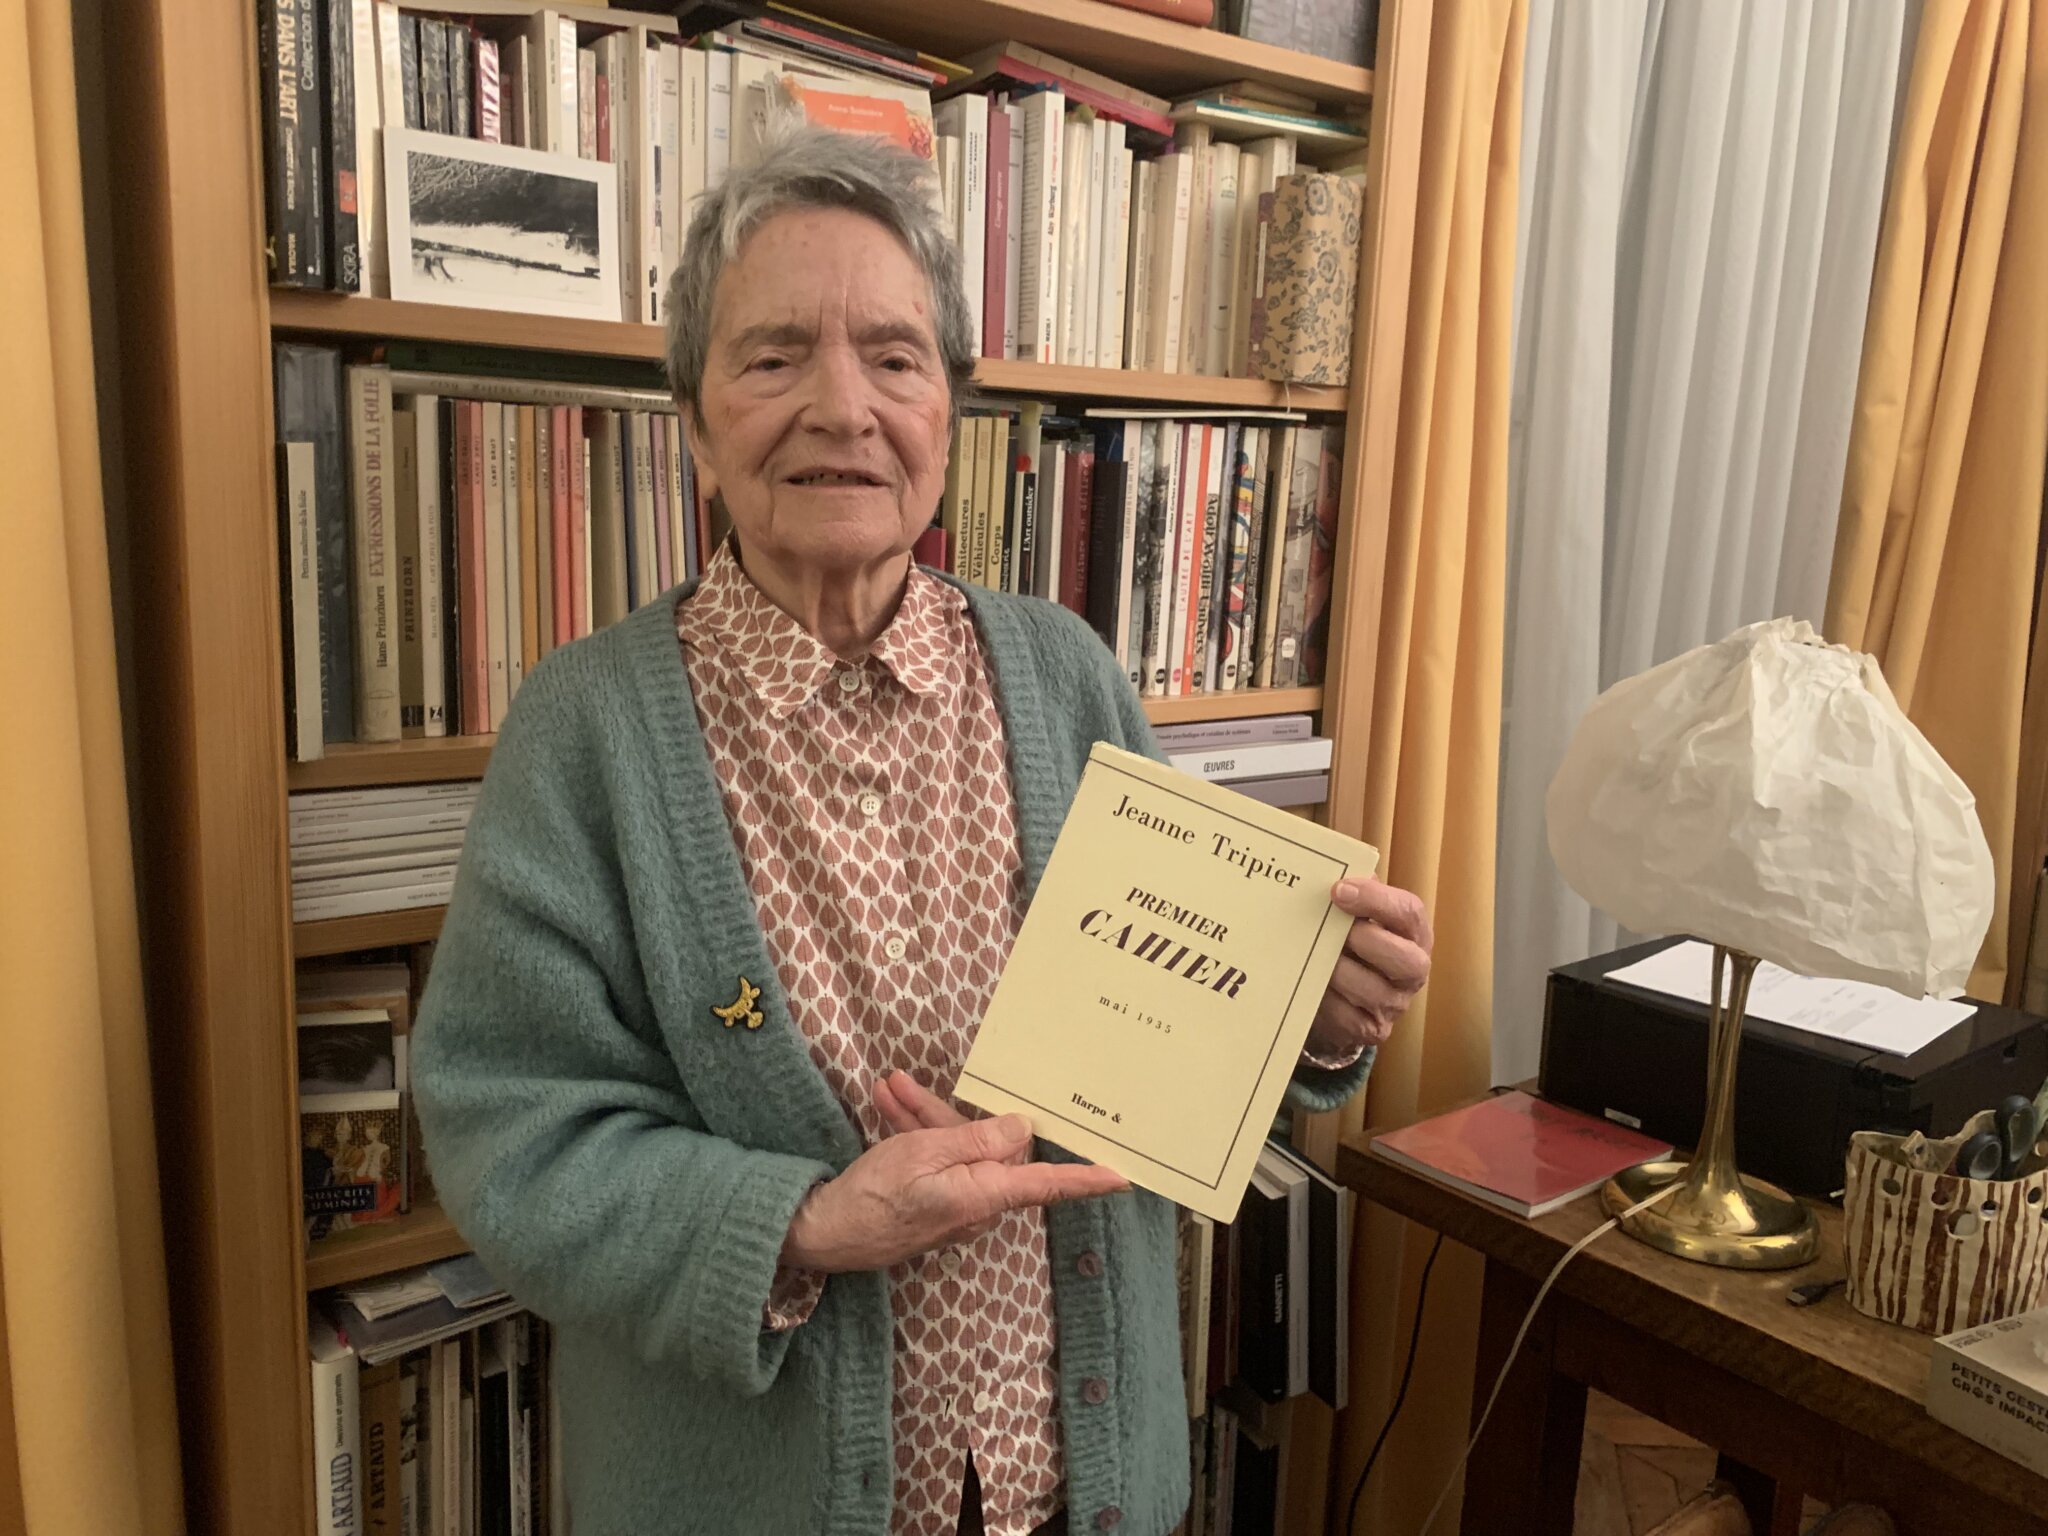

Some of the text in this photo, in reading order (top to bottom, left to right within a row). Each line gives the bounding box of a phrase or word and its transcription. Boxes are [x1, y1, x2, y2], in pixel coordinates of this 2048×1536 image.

[277, 13, 297, 68] DANS
[301, 13, 314, 91] Collection
[278, 69, 298, 125] L'ART
[343, 242, 358, 285] SKIRA
[364, 379, 380, 423] FOLIE
[365, 426, 381, 447] LA
[365, 450, 381, 471] DE
[367, 475, 385, 578] EXPRESSIONS
[959, 498, 969, 581] rchitectures
[972, 512, 986, 578] Véhicules
[990, 525, 1003, 565] Corps
[1023, 485, 1034, 552] L'Art outsider
[1178, 568, 1189, 612] L'AUTRE
[1184, 511, 1194, 542] L'ART
[403, 556, 415, 642] PRINZHORN
[376, 641, 388, 669] Hans
[1203, 759, 1235, 773] ŒUVRES
[1113, 794, 1300, 890] Jeanne Tripier
[1125, 886, 1230, 944] PREMIER
[1079, 909, 1249, 1001] CAHIER
[1098, 994, 1173, 1035] mai 1935
[1070, 1092, 1123, 1125] Harpo &
[1951, 1361, 2002, 1396] PETITS
[1999, 1401, 2048, 1434] IMPAC
[330, 1452, 353, 1528] ARTAUD
[368, 1422, 385, 1510] ARTAUD
